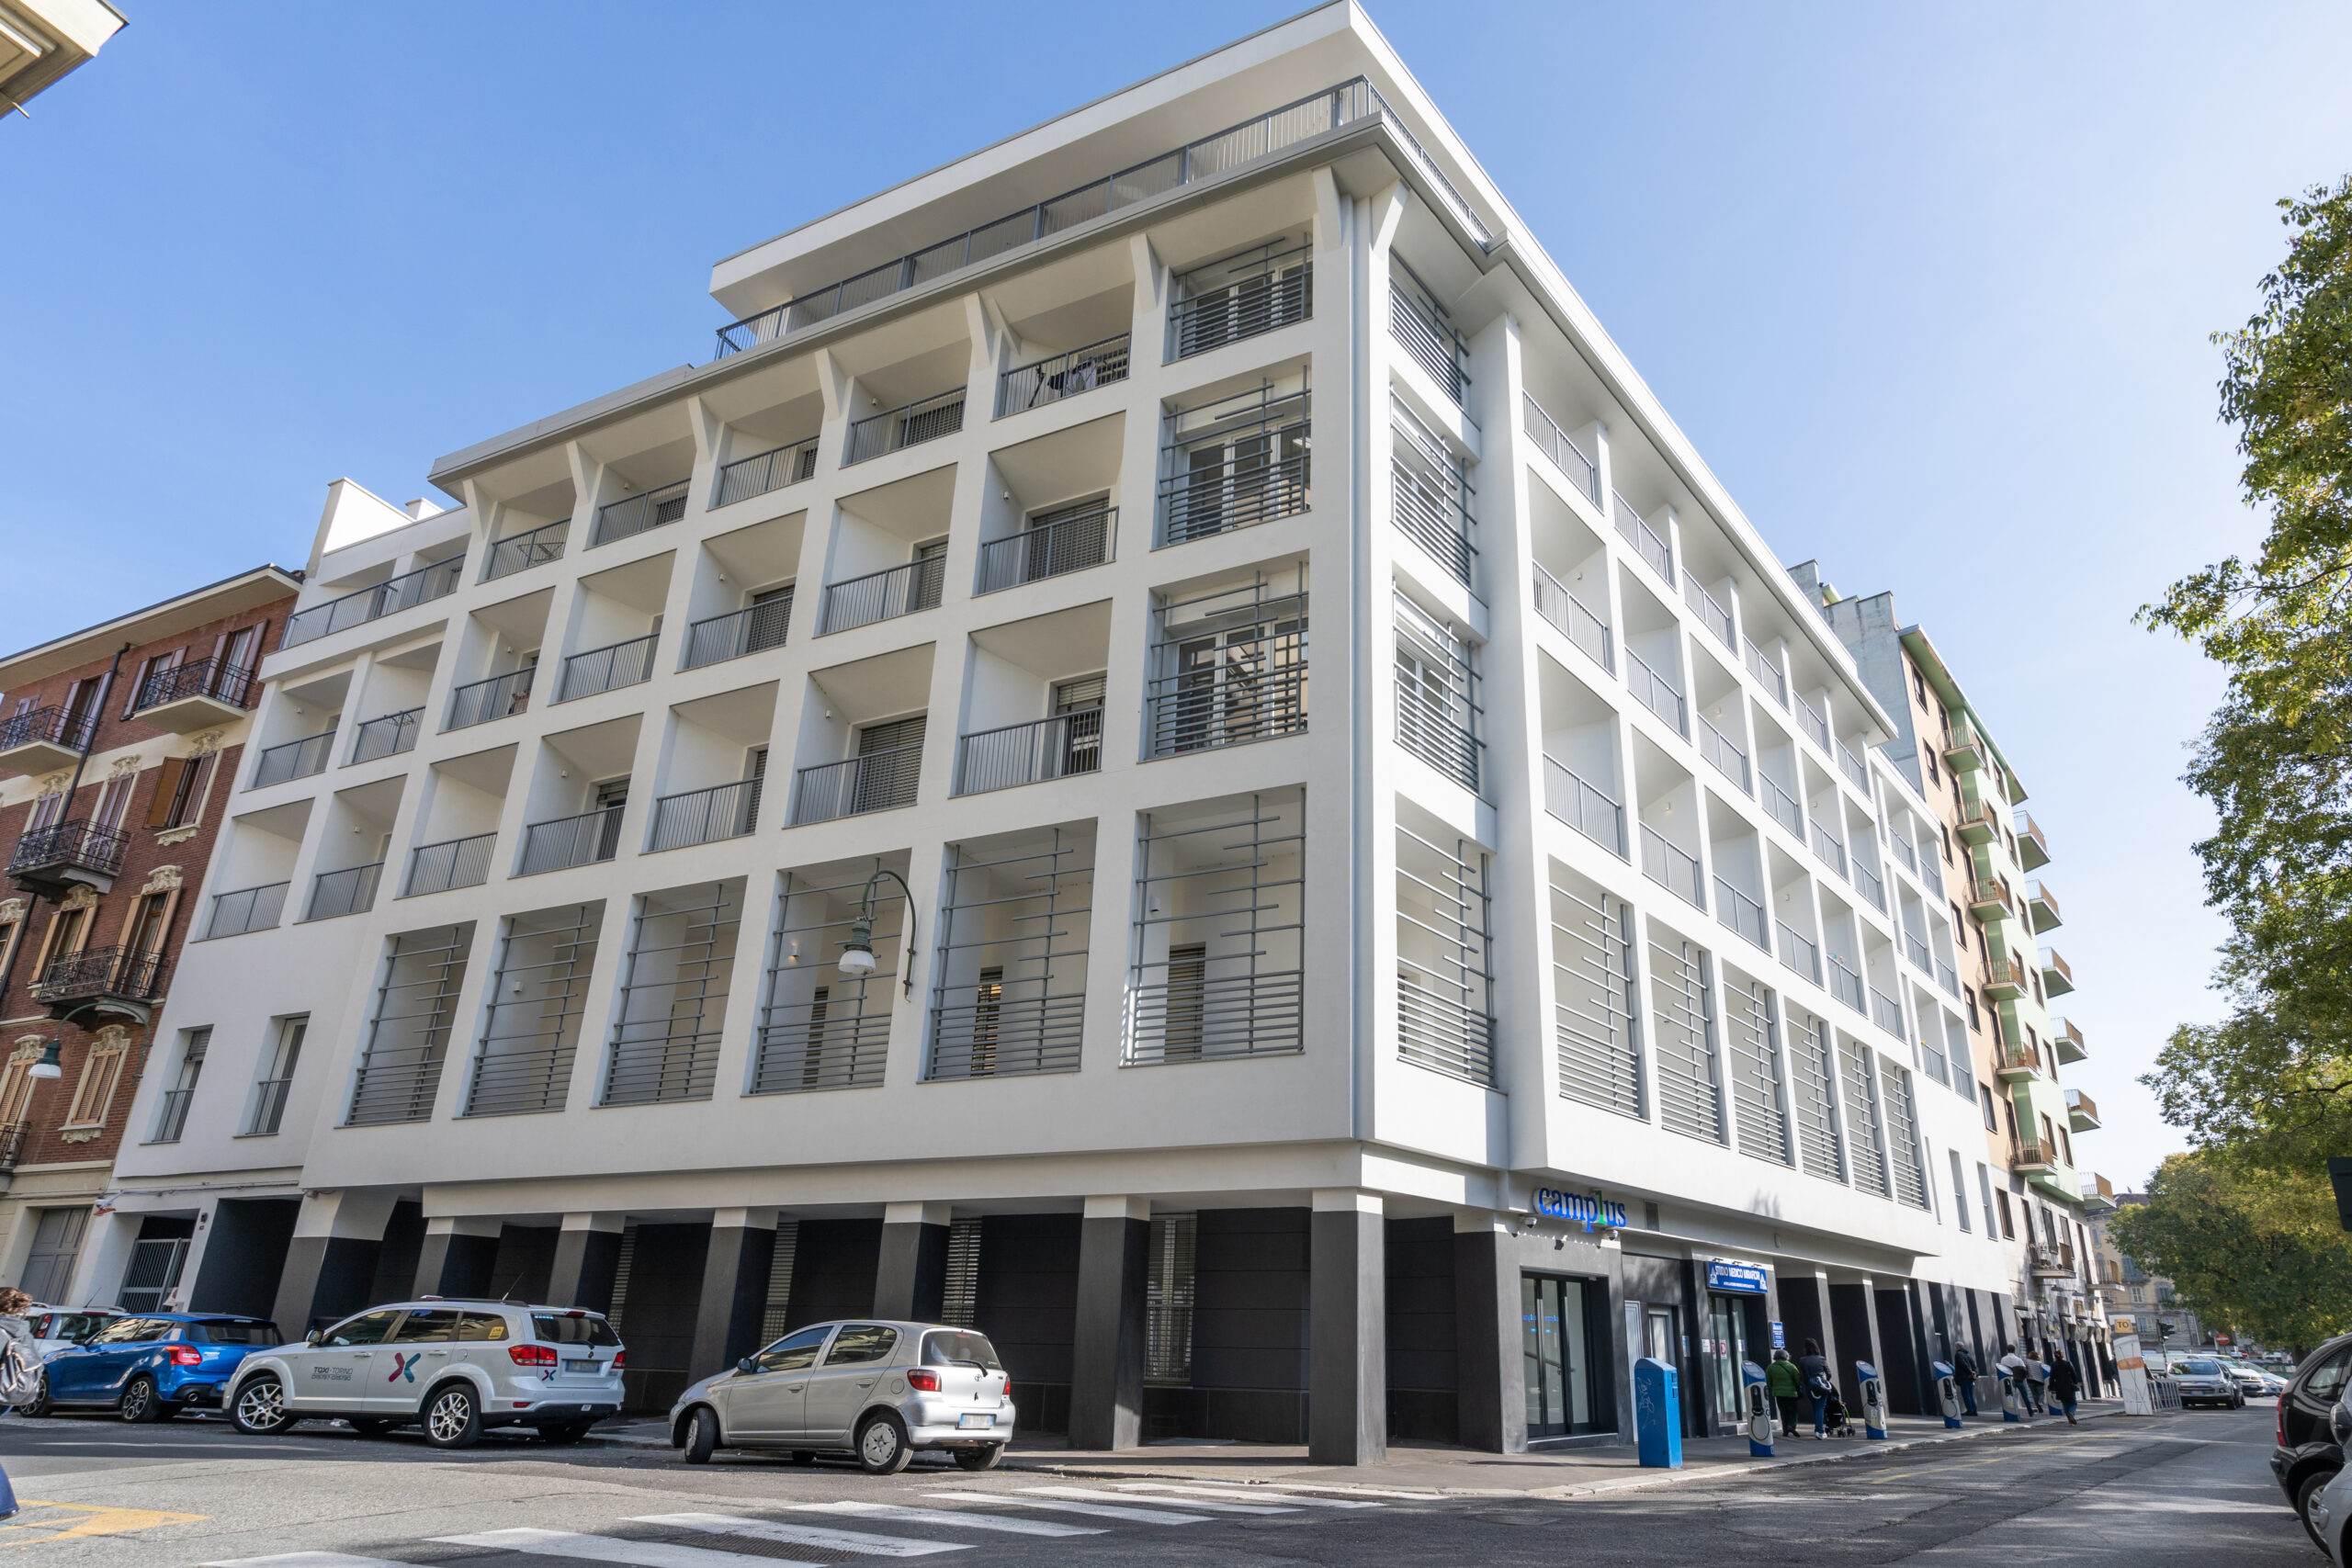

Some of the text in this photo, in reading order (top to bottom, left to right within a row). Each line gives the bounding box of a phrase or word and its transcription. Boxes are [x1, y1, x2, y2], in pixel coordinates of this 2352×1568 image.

[1538, 1187, 1627, 1234] camplus
[1714, 1265, 1728, 1277] STUDIO
[1728, 1267, 1743, 1279] MEDICO
